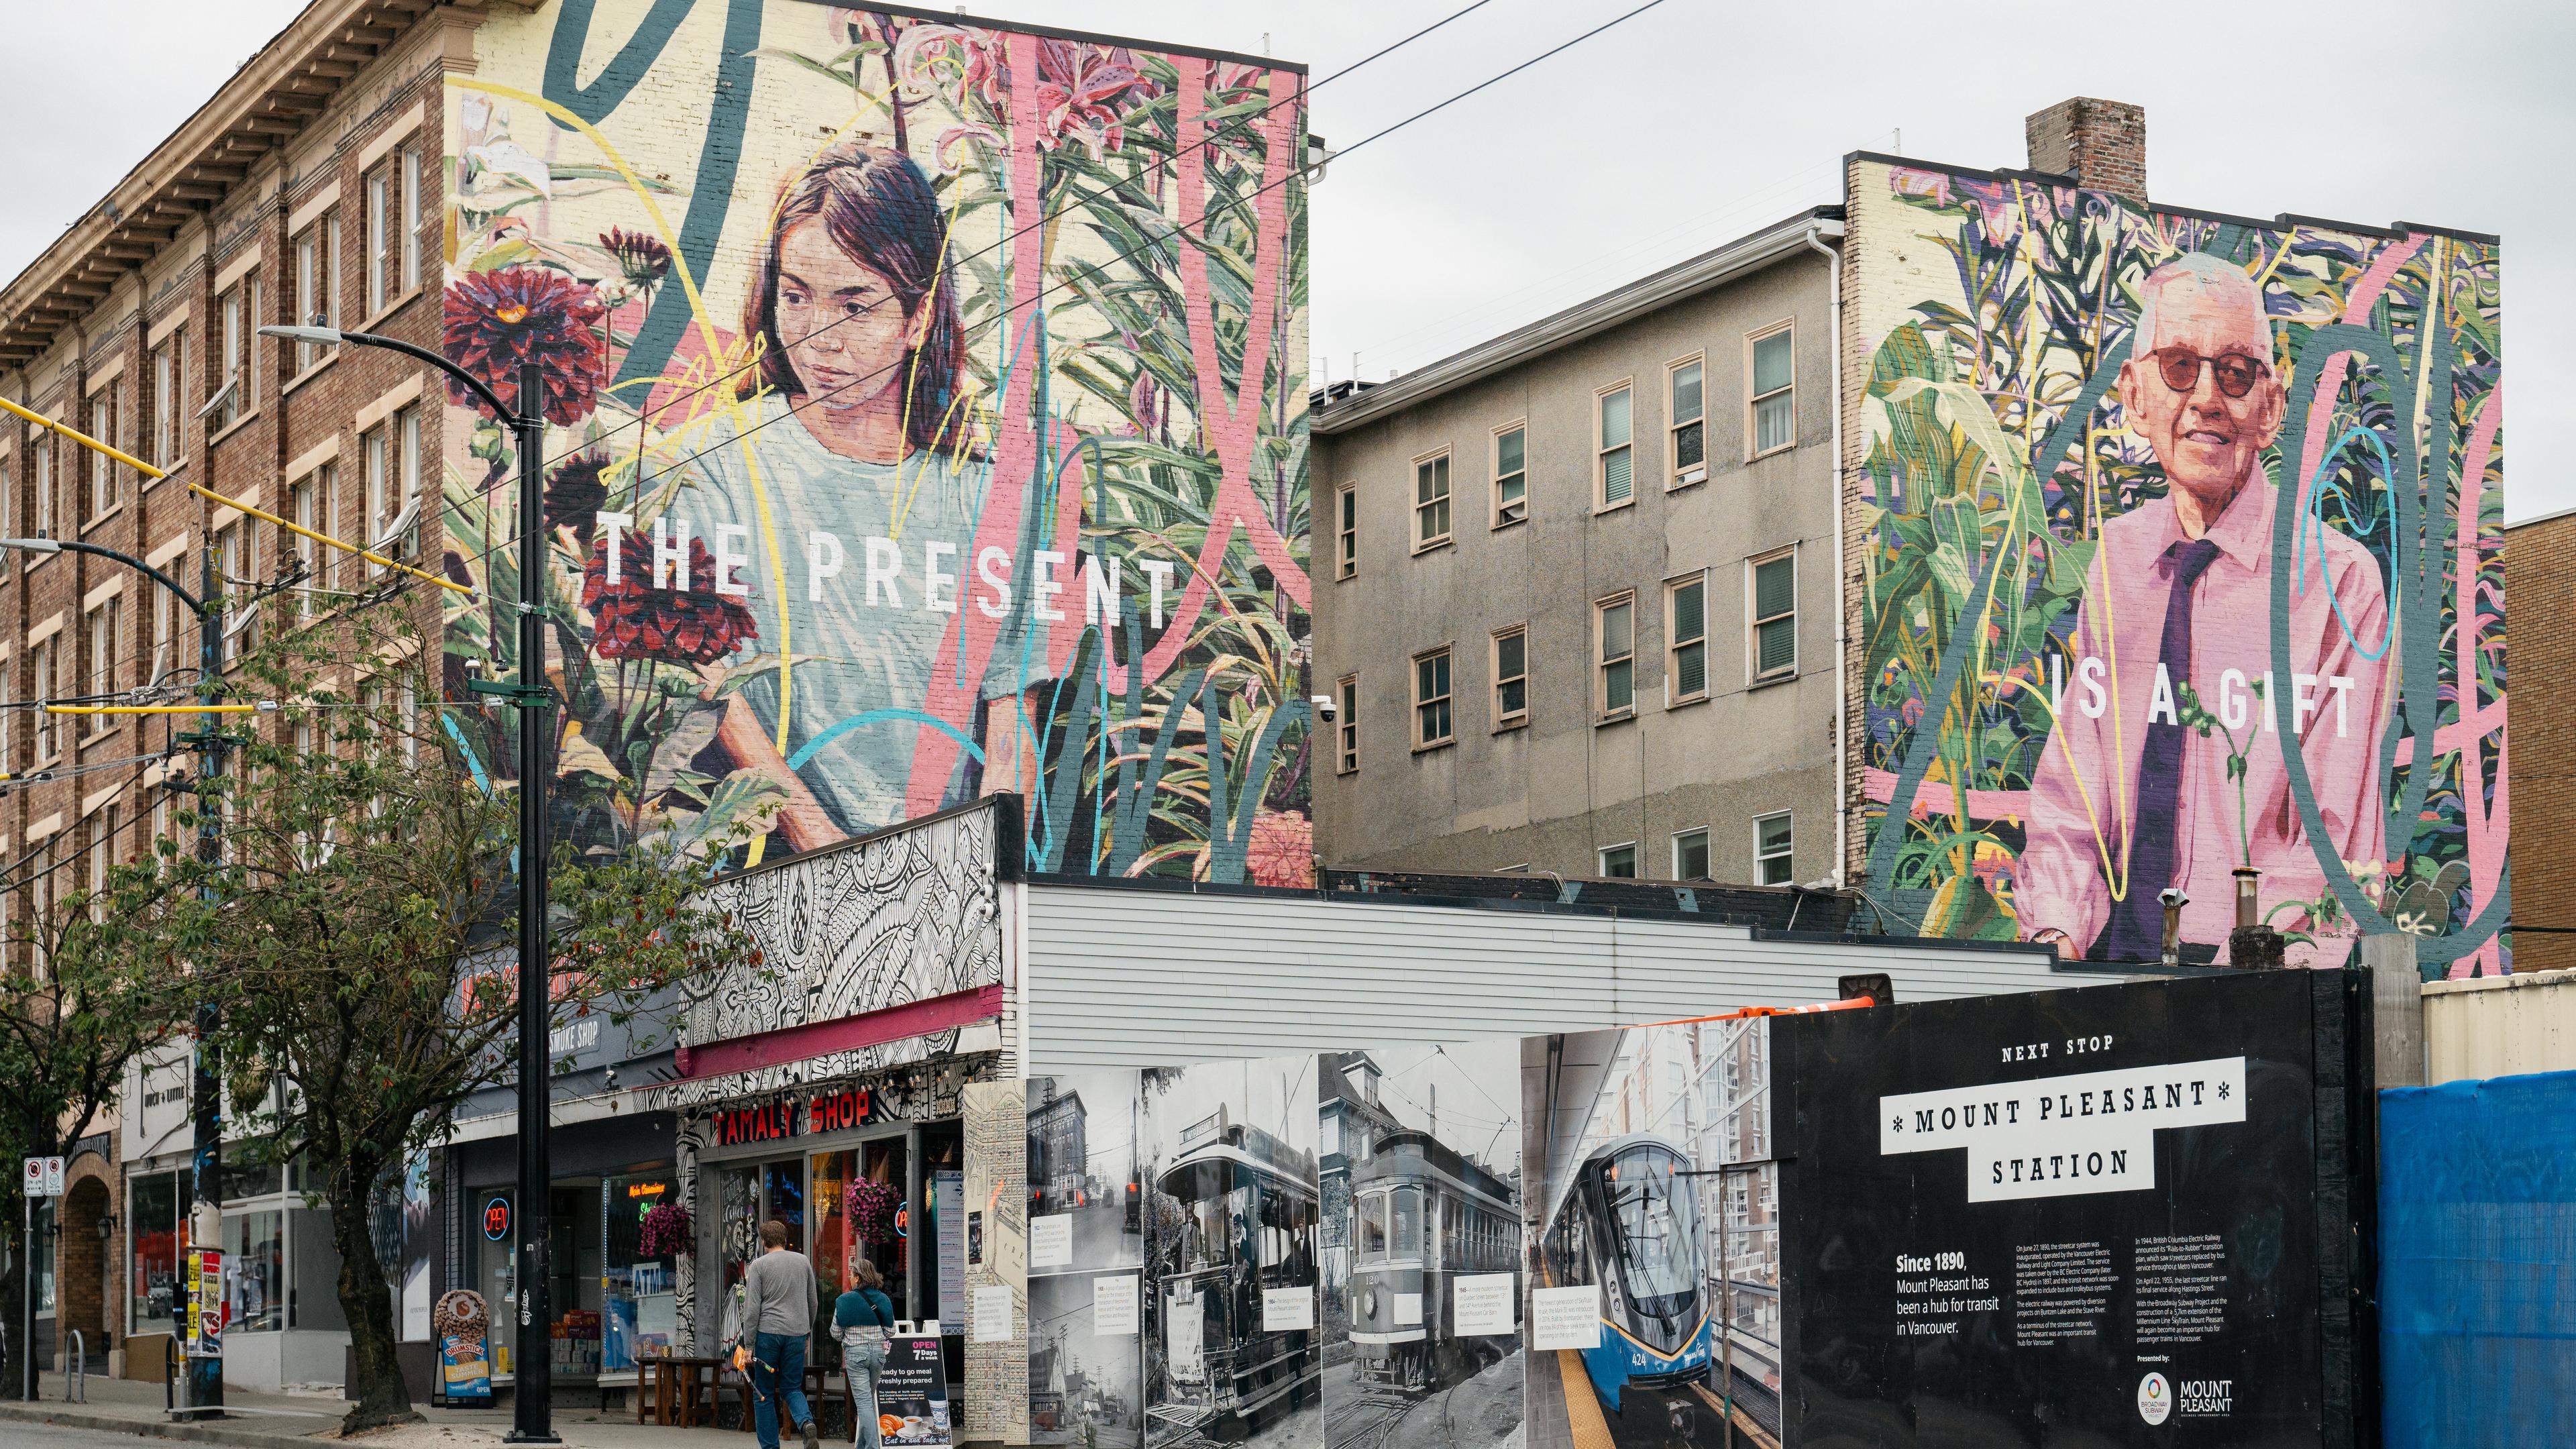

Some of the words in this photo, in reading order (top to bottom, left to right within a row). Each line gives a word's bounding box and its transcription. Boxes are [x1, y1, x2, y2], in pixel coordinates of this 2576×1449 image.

[596, 511, 749, 595] THE
[808, 530, 1174, 629] PRESENT
[2052, 654, 2106, 718] IS
[2148, 663, 2178, 726] A
[2220, 667, 2354, 737] GIFT
[549, 1024, 575, 1054] SMOKE
[577, 1020, 598, 1048] SHOP
[2002, 1042, 2049, 1063] NEXT
[2067, 1035, 2113, 1055] STOP
[1915, 1099, 2020, 1133] MOUNT
[2041, 1080, 2205, 1120] PLEASANT
[714, 1103, 793, 1146] TAMALY
[810, 1090, 869, 1133] SHOP
[1992, 1149, 2127, 1185] STATION
[485, 1207, 507, 1231] OPEN
[1896, 1254, 1931, 1273] Since
[1935, 1252, 1967, 1271] 1890,
[2017, 1253, 2041, 1261] inaugurated,
[2136, 1256, 2146, 1264] plan,
[2192, 1253, 2210, 1261] replaced
[2210, 1252, 2216, 1260] by
[2017, 1262, 2031, 1270] Railway
[2041, 1260, 2050, 1269] Light
[635, 1269, 659, 1295] ATM
[1366, 1275, 1379, 1285] 120
[1897, 1279, 1927, 1293] Mount
[1930, 1277, 1969, 1292] Pleasant
[1972, 1275, 1989, 1290] has
[1897, 1300, 1920, 1315] been
[1923, 1303, 1928, 1313] a
[1931, 1298, 1948, 1313] hub
[1951, 1297, 1964, 1312] for
[1967, 1296, 1999, 1311] transit
[2178, 1299, 2194, 1307] Subway
[2195, 1298, 2210, 1307] Project
[1897, 1322, 1906, 1335] in
[1908, 1321, 1958, 1335] Vancouver.
[2172, 1317, 2190, 1326] SkyTrain,
[446, 1344, 484, 1356] DRUMSTICK
[913, 1350, 921, 1360] 7
[1632, 1354, 1646, 1366] 424
[451, 1369, 483, 1379] SUMMER
[456, 1364, 478, 1373] TASTE
[2181, 1381, 2232, 1398] MOUNT
[2181, 1399, 2232, 1412] PLEASANT
[885, 1436, 898, 1444] Eat
